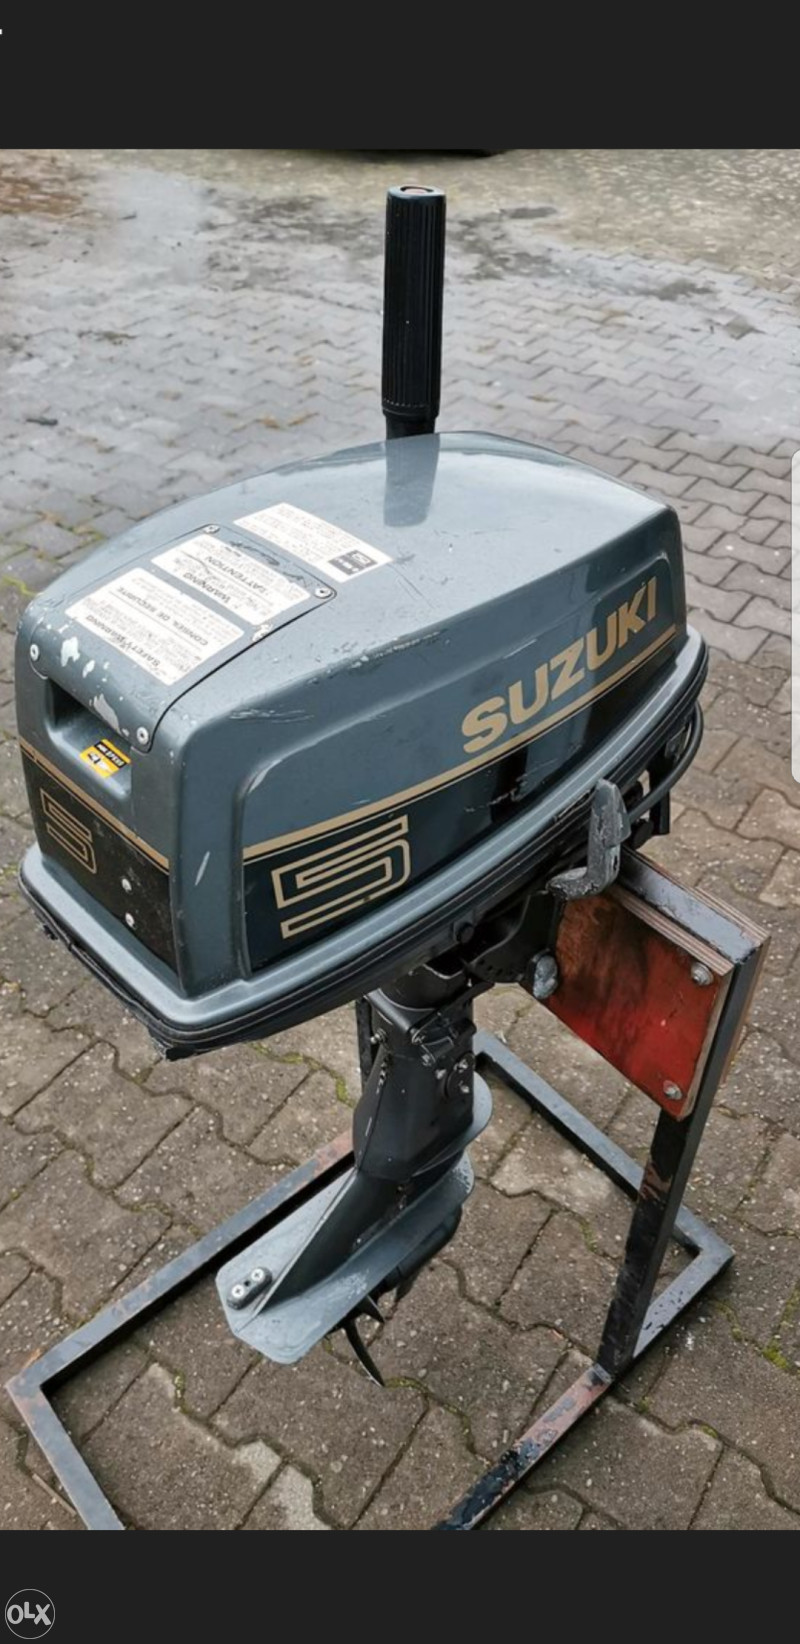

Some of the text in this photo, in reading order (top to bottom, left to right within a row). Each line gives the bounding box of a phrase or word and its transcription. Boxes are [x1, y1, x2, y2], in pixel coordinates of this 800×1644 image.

[461, 576, 657, 753] SUZUKI
[40, 788, 97, 875] 5
[271, 814, 411, 939] 5
